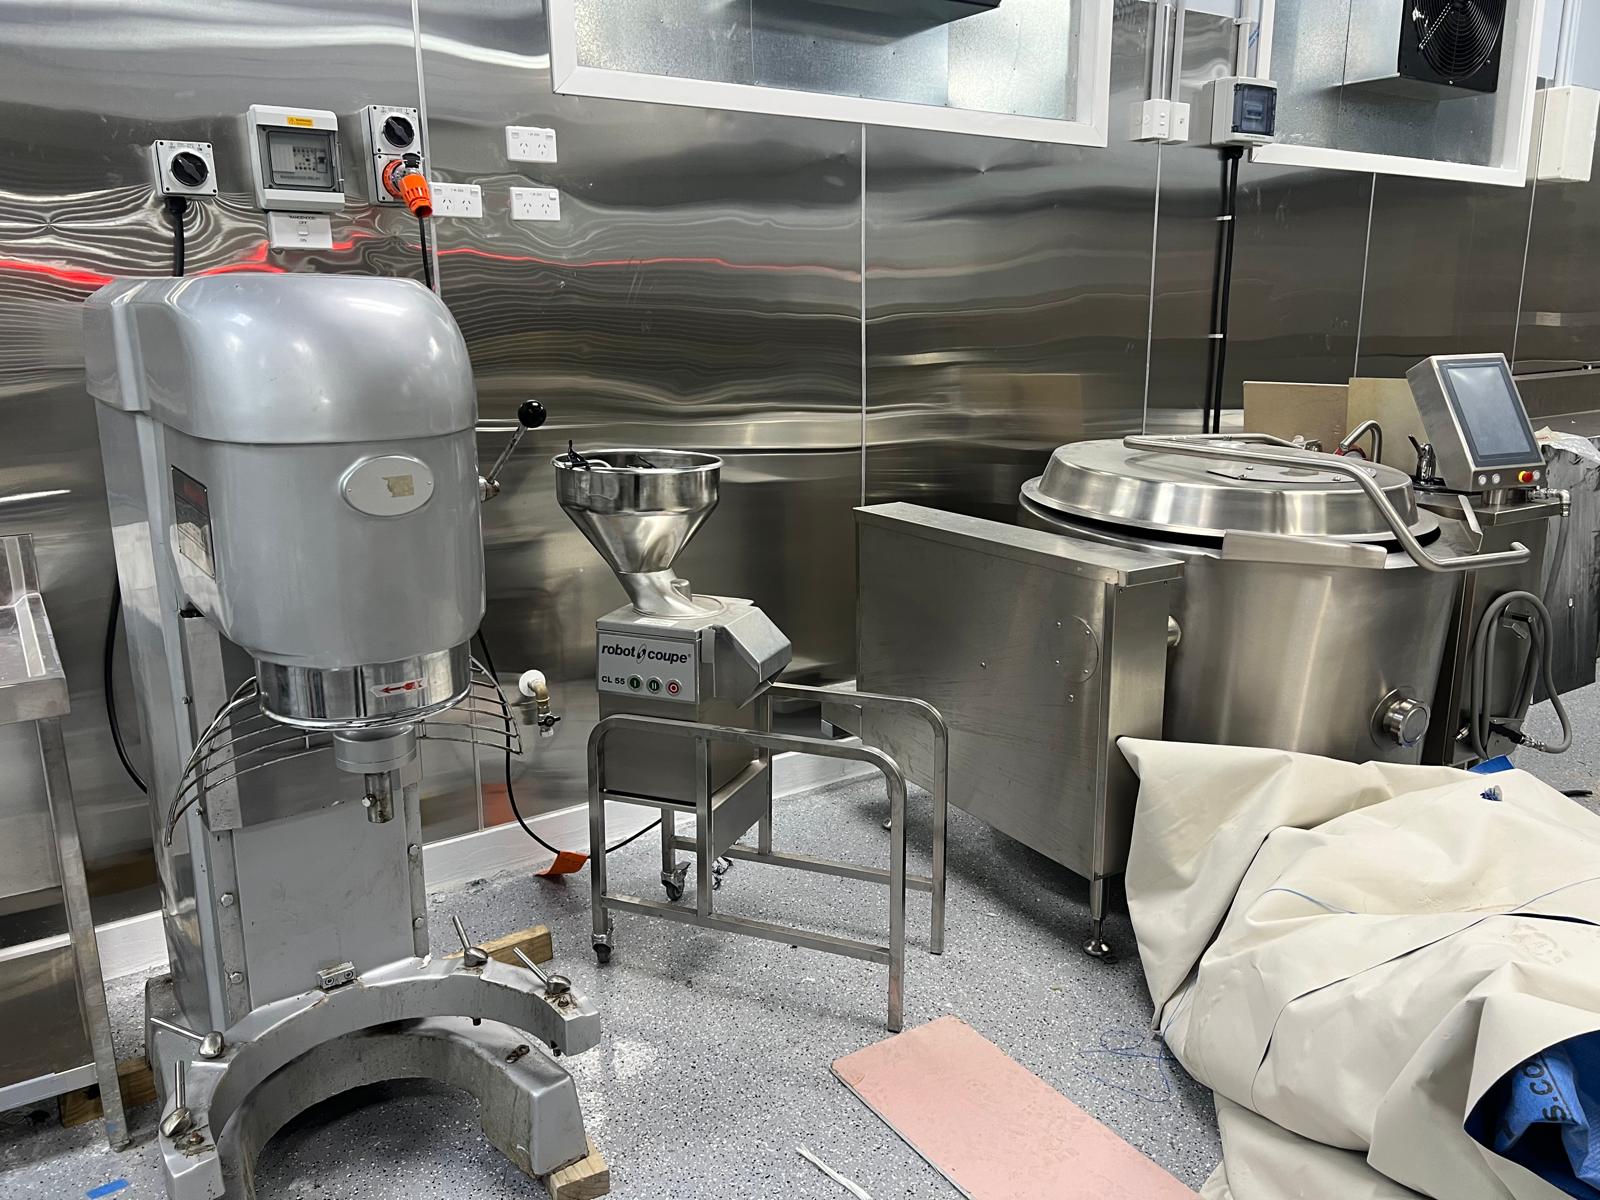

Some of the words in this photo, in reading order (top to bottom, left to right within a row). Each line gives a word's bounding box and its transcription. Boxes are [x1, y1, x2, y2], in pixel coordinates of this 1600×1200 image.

[601, 644, 636, 658] robot
[647, 650, 688, 664] coupe
[601, 675, 613, 684] CL
[614, 677, 626, 685] 55
